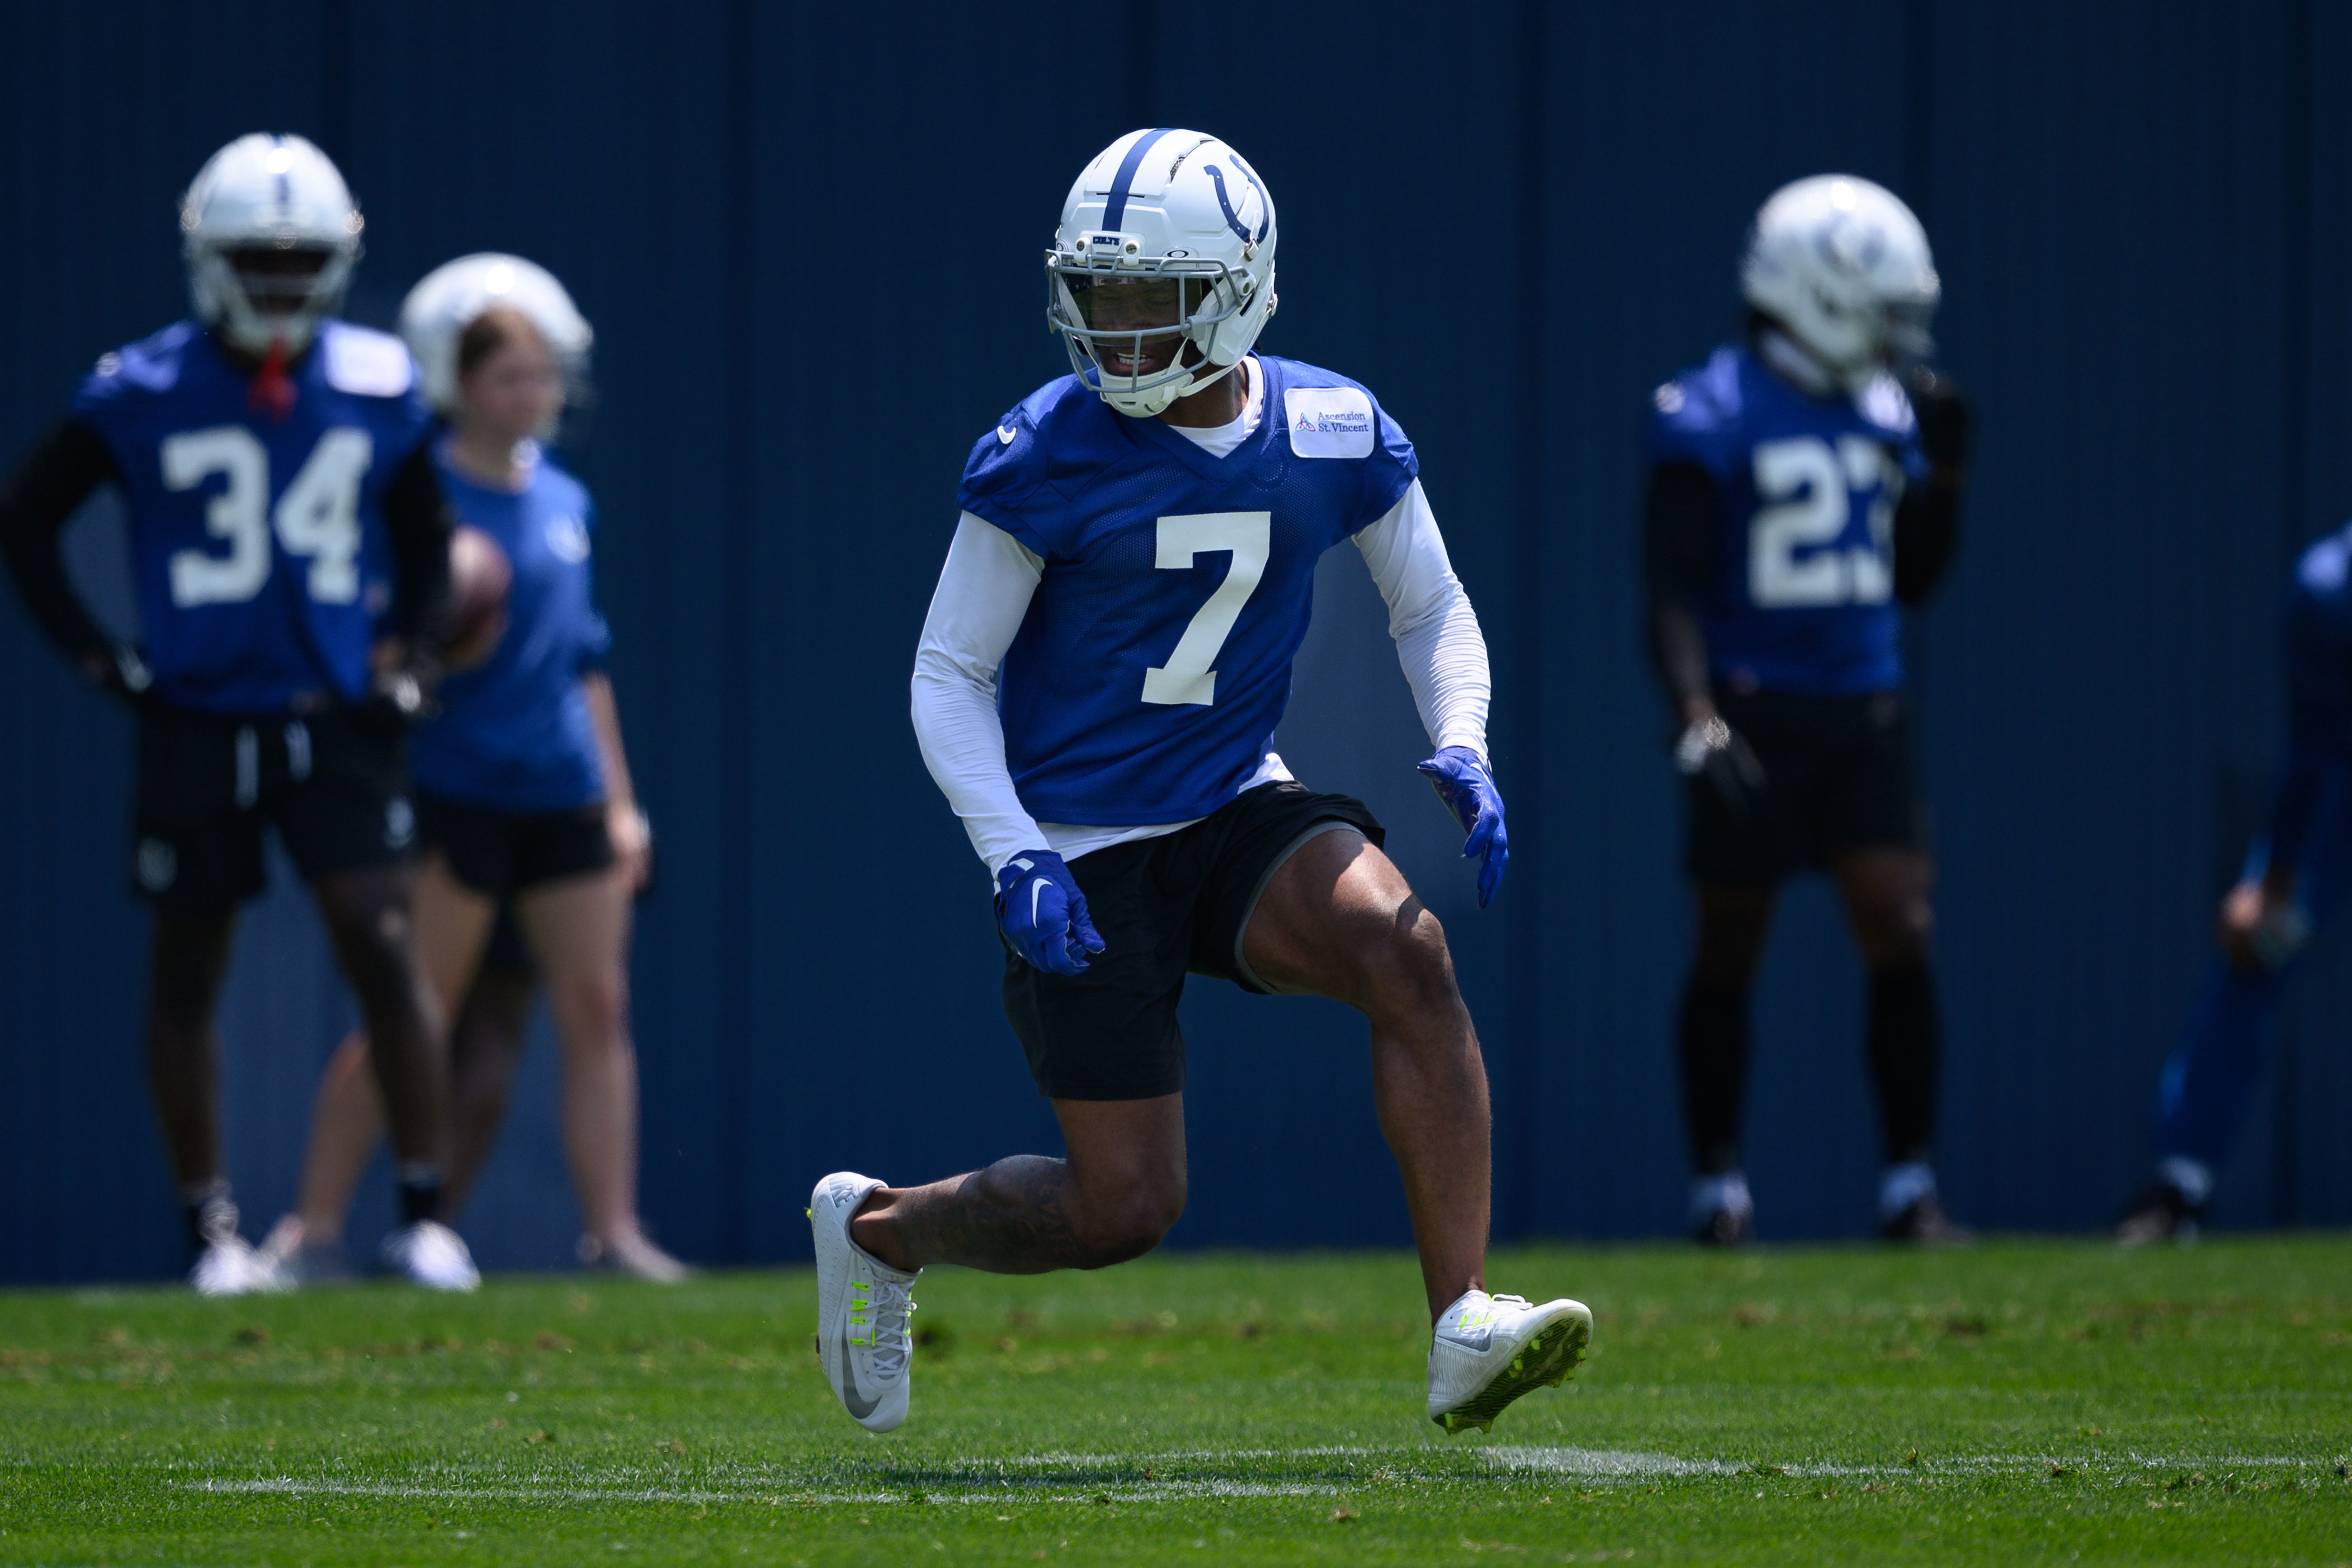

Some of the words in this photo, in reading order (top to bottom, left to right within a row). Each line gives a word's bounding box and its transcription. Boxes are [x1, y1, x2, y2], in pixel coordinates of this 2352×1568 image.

[1317, 412, 1366, 421] Ascension
[1318, 423, 1331, 432] St.
[1331, 423, 1369, 432] Vincent
[160, 425, 373, 607] 34
[1141, 511, 1271, 706] 7
